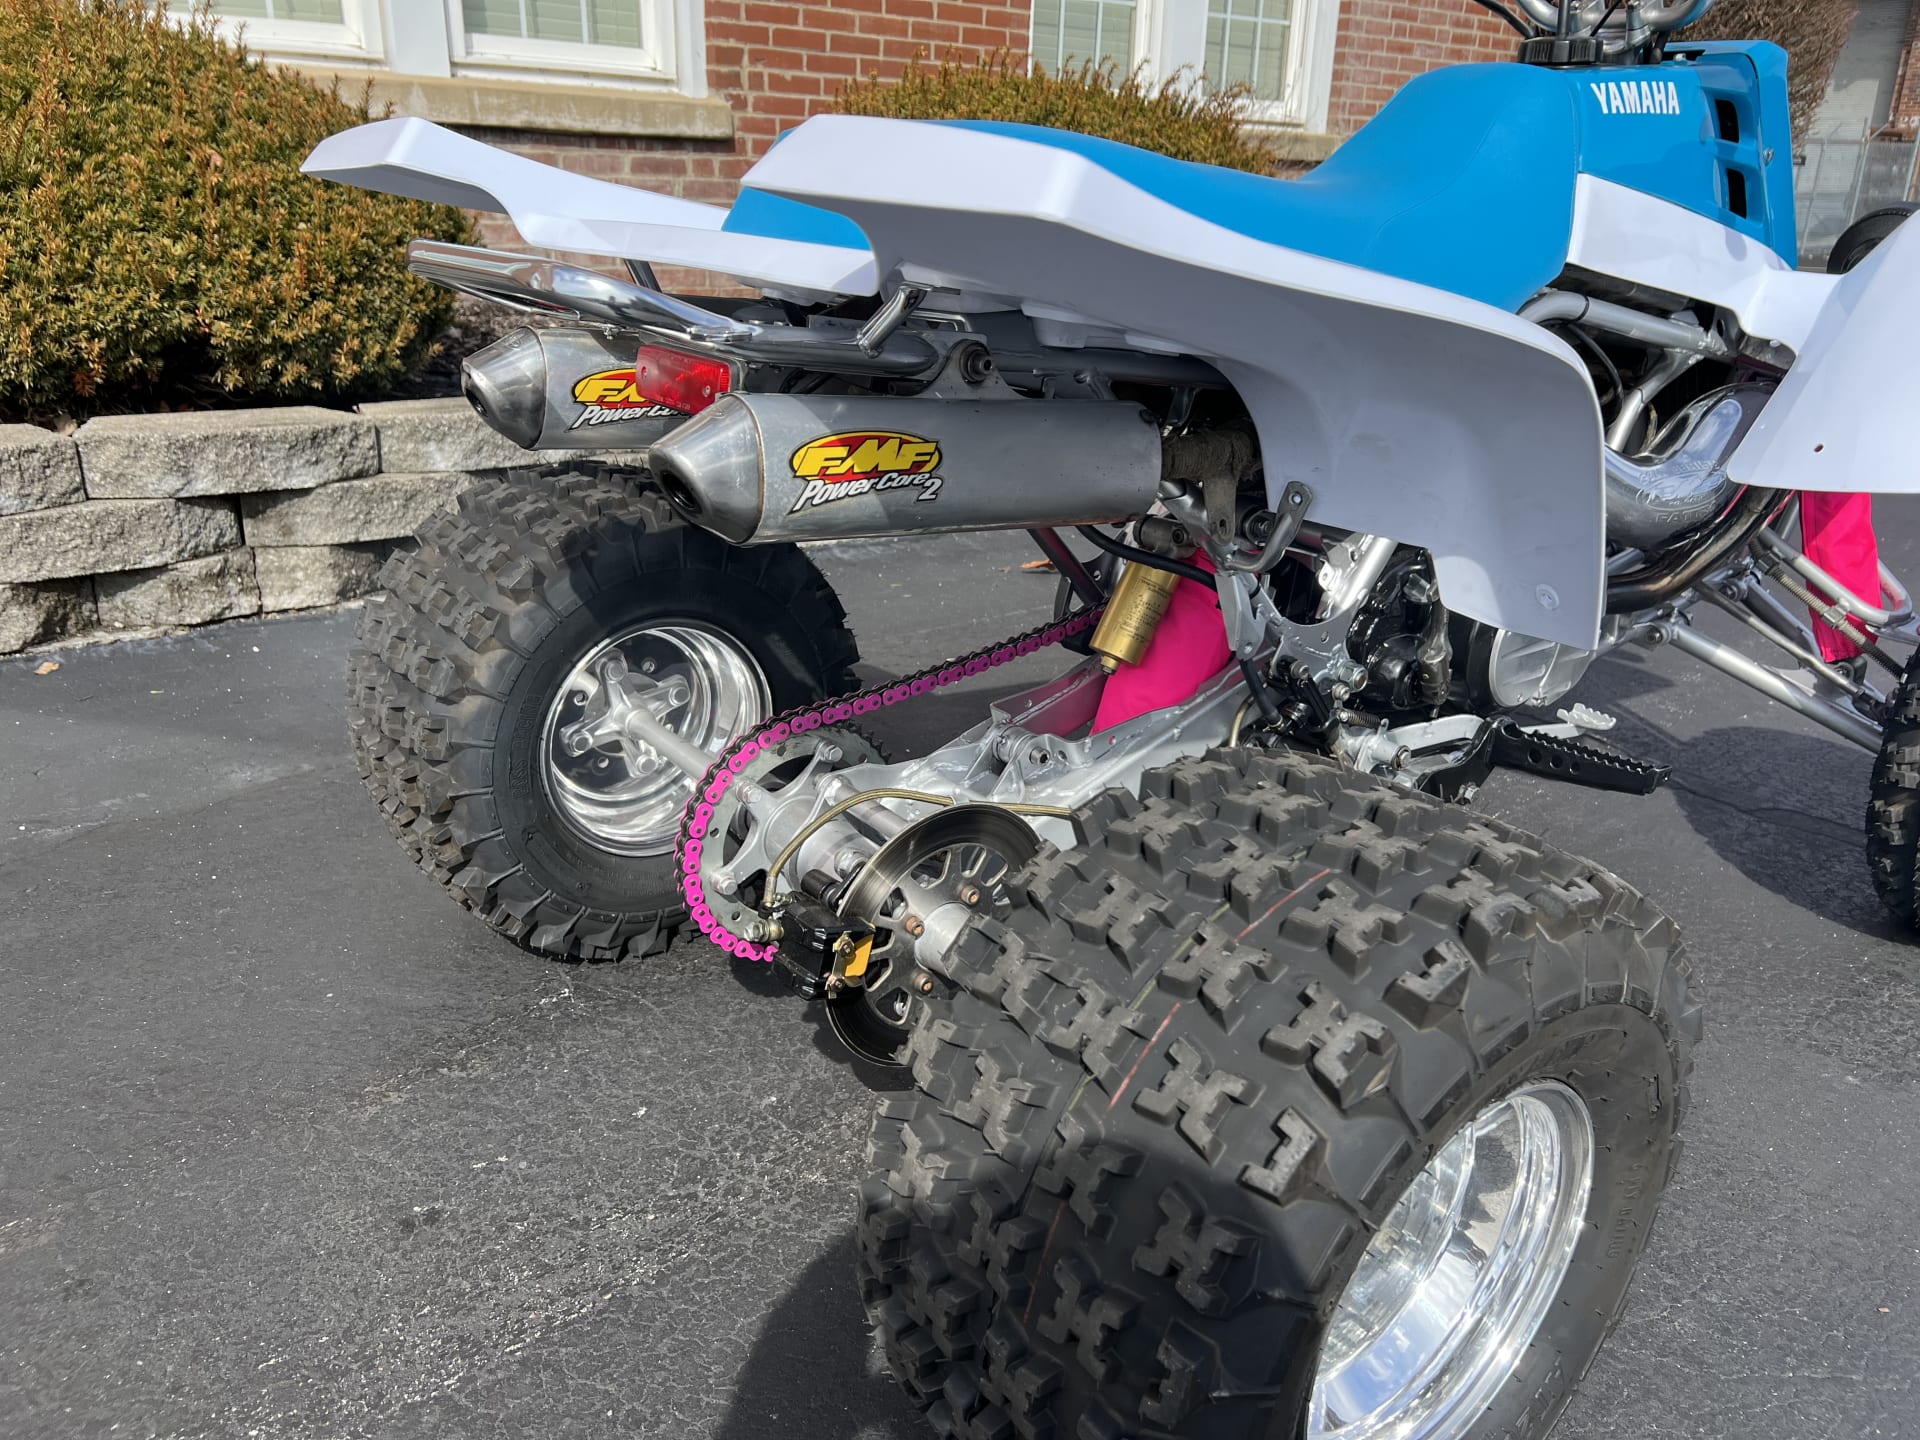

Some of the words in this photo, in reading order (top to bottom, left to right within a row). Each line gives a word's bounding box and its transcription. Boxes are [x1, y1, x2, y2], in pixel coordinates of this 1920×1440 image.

[1590, 81, 1680, 115] YAMAHA
[795, 437, 937, 476] FMF
[918, 478, 942, 500] 2
